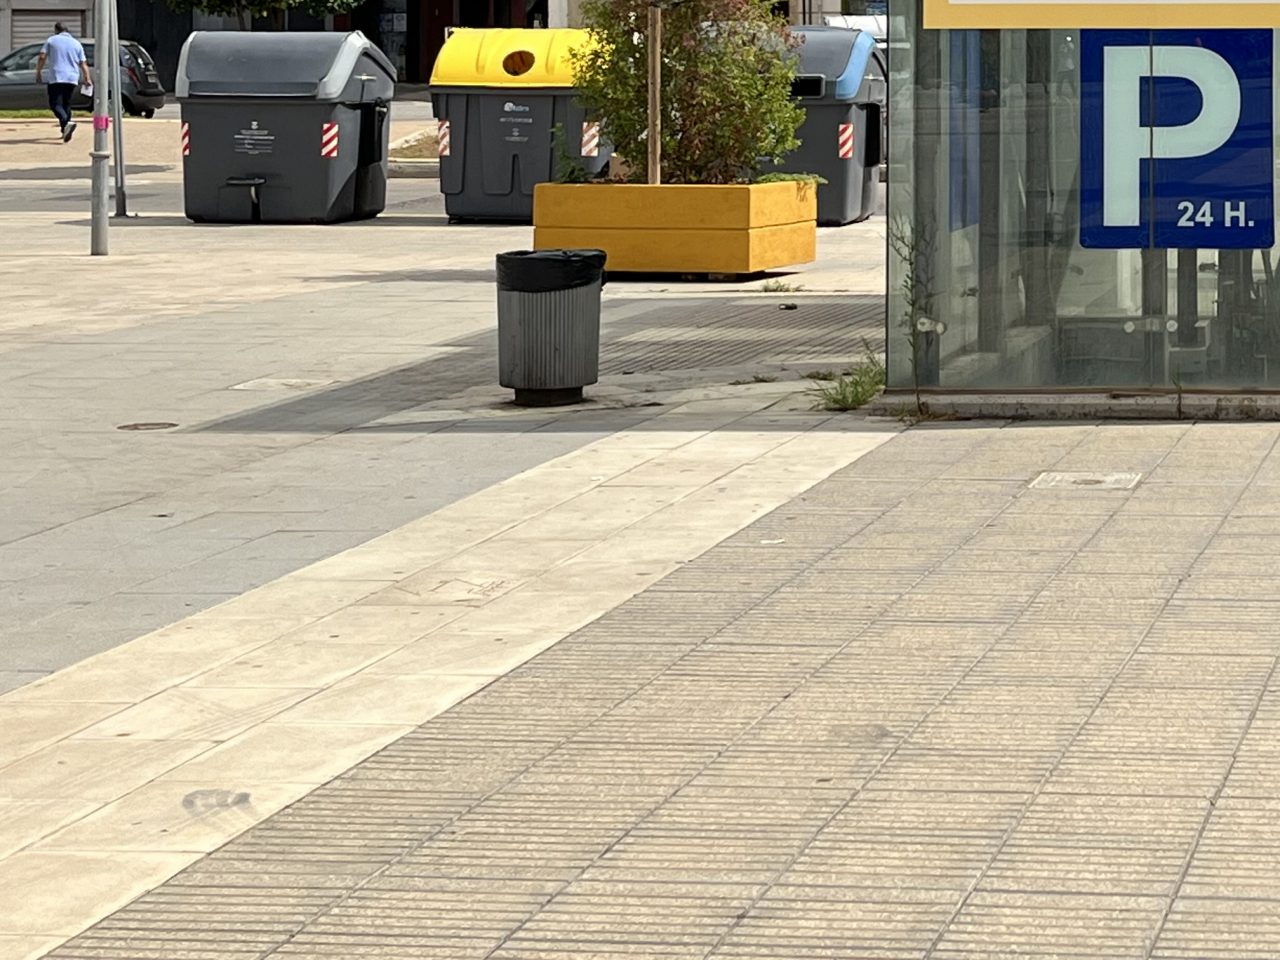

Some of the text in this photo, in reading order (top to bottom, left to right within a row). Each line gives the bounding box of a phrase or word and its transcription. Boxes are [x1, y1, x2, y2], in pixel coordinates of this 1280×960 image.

[1103, 45, 1241, 227] P
[1176, 201, 1255, 227] 24 H.
